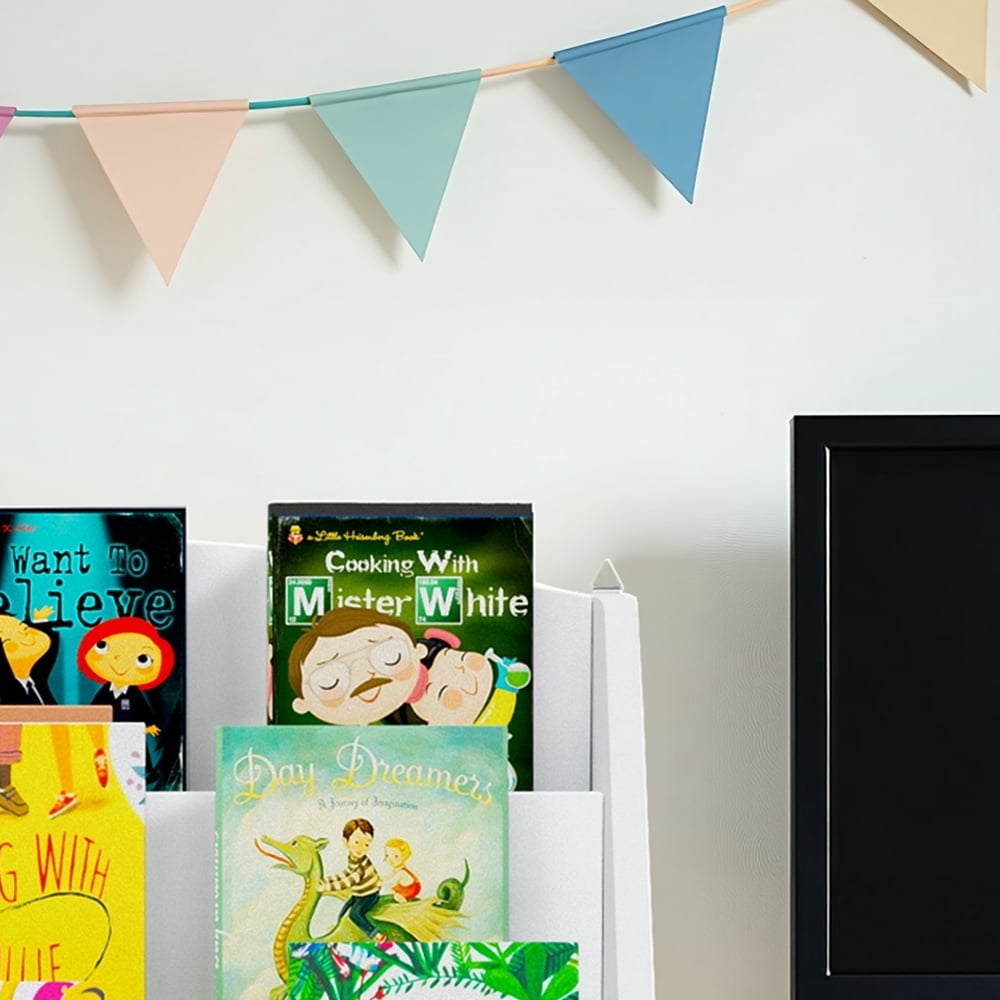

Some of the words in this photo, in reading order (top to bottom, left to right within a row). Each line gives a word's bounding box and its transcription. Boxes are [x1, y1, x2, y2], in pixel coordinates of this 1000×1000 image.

[10, 543, 91, 575] Want
[108, 543, 149, 576] To
[325, 550, 415, 577] Cooking
[416, 550, 479, 574] With
[293, 586, 412, 617] Mister
[418, 586, 529, 617] White
[233, 746, 316, 805] Day
[330, 735, 494, 806] Dreamers
[35, 831, 111, 900] WITH
